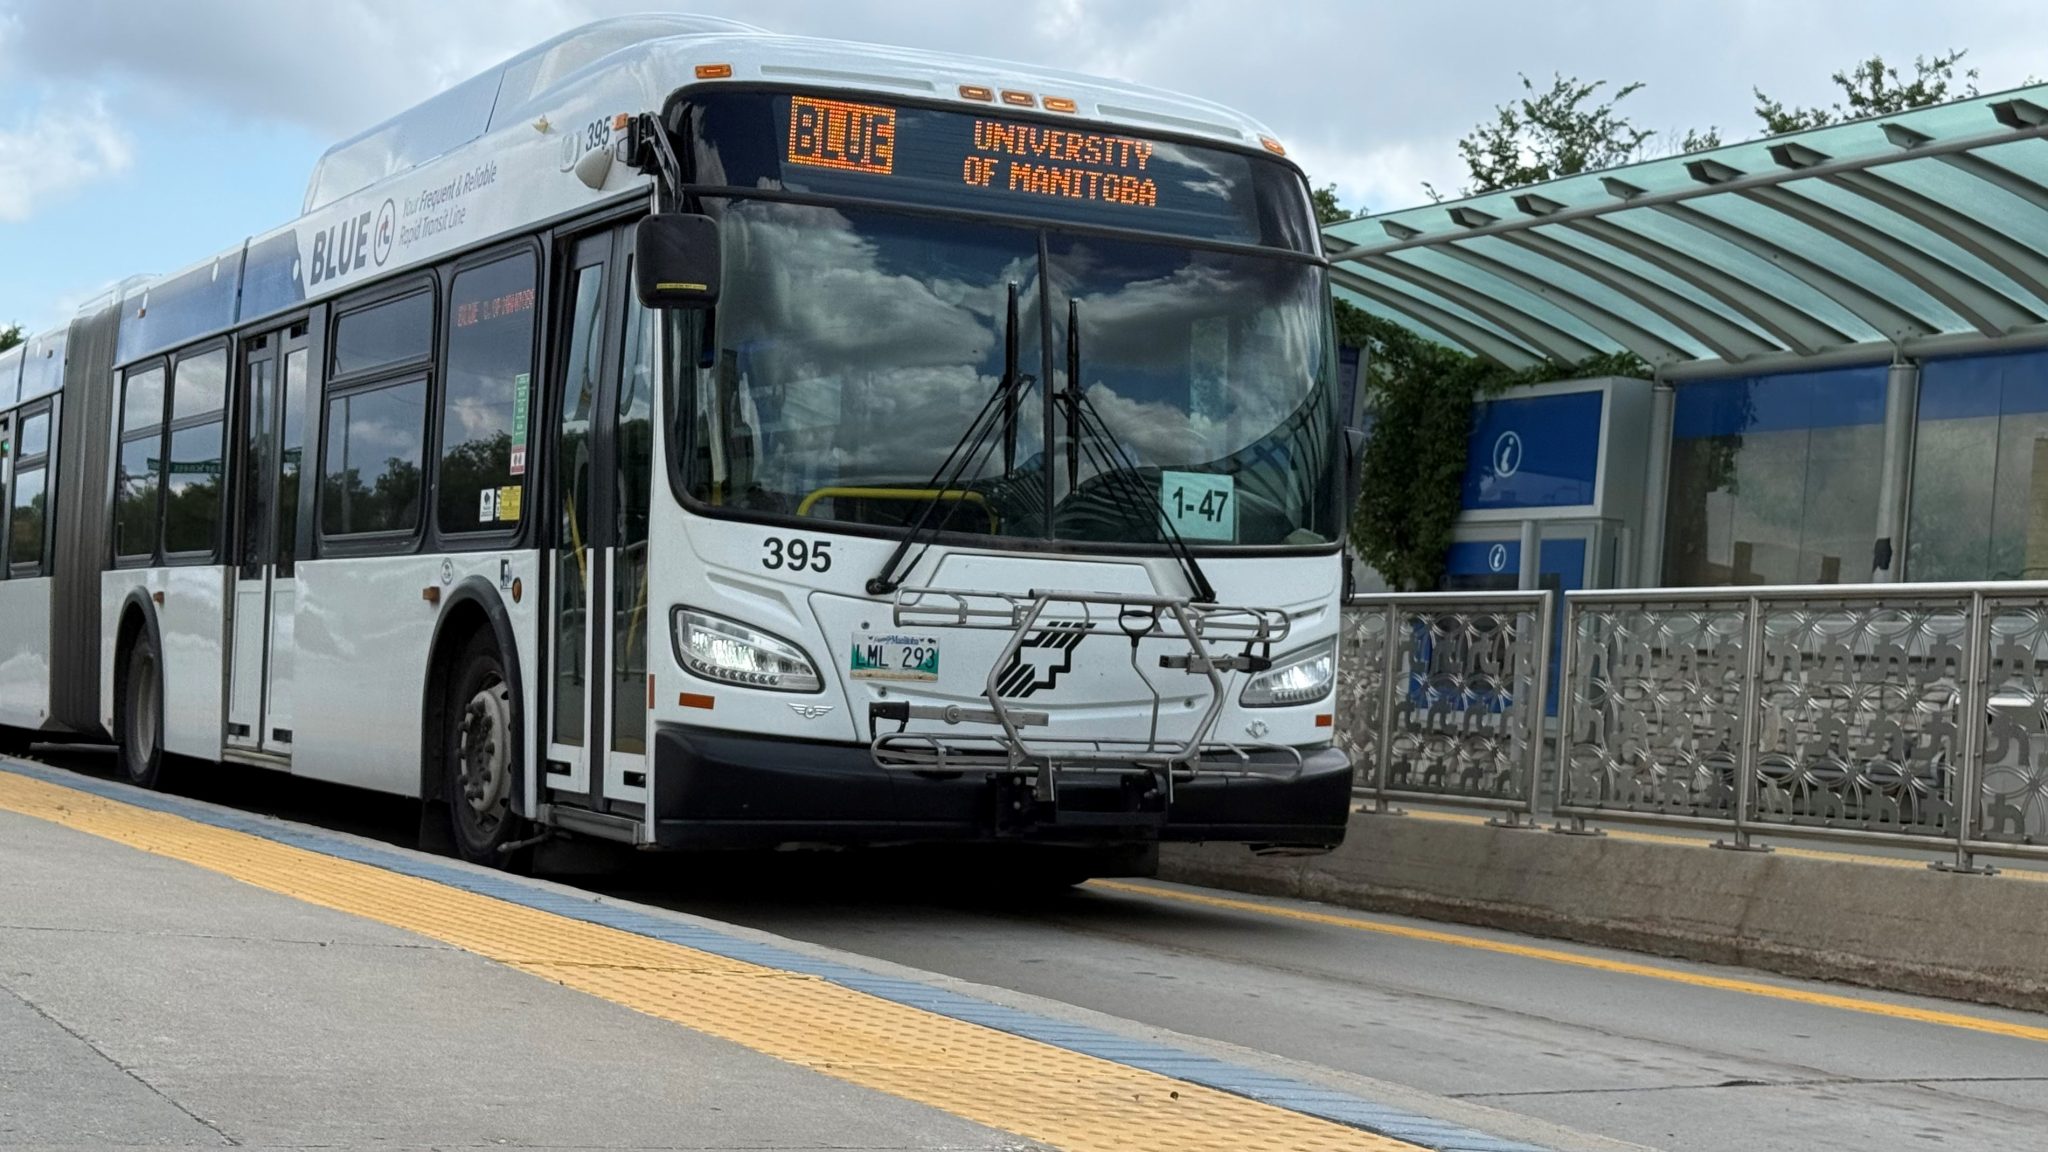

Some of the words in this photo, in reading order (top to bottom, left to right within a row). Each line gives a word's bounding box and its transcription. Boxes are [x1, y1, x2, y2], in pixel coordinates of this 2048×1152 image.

[585, 115, 611, 151] 395
[789, 96, 896, 174] BLUE
[974, 120, 1153, 170] UNIVERSITY
[402, 195, 420, 218] Your
[419, 178, 456, 213] Frequent
[455, 174, 463, 198] &
[463, 160, 497, 195] Reliable
[963, 156, 999, 187] OF
[1009, 161, 1157, 207] MANITOBA
[310, 210, 371, 286] BLUE
[399, 217, 423, 249] Rapid
[422, 209, 449, 239] Transit
[448, 205, 467, 229] Line
[762, 536, 832, 573] 395
[856, 643, 889, 668] LML
[901, 645, 936, 669] 293
